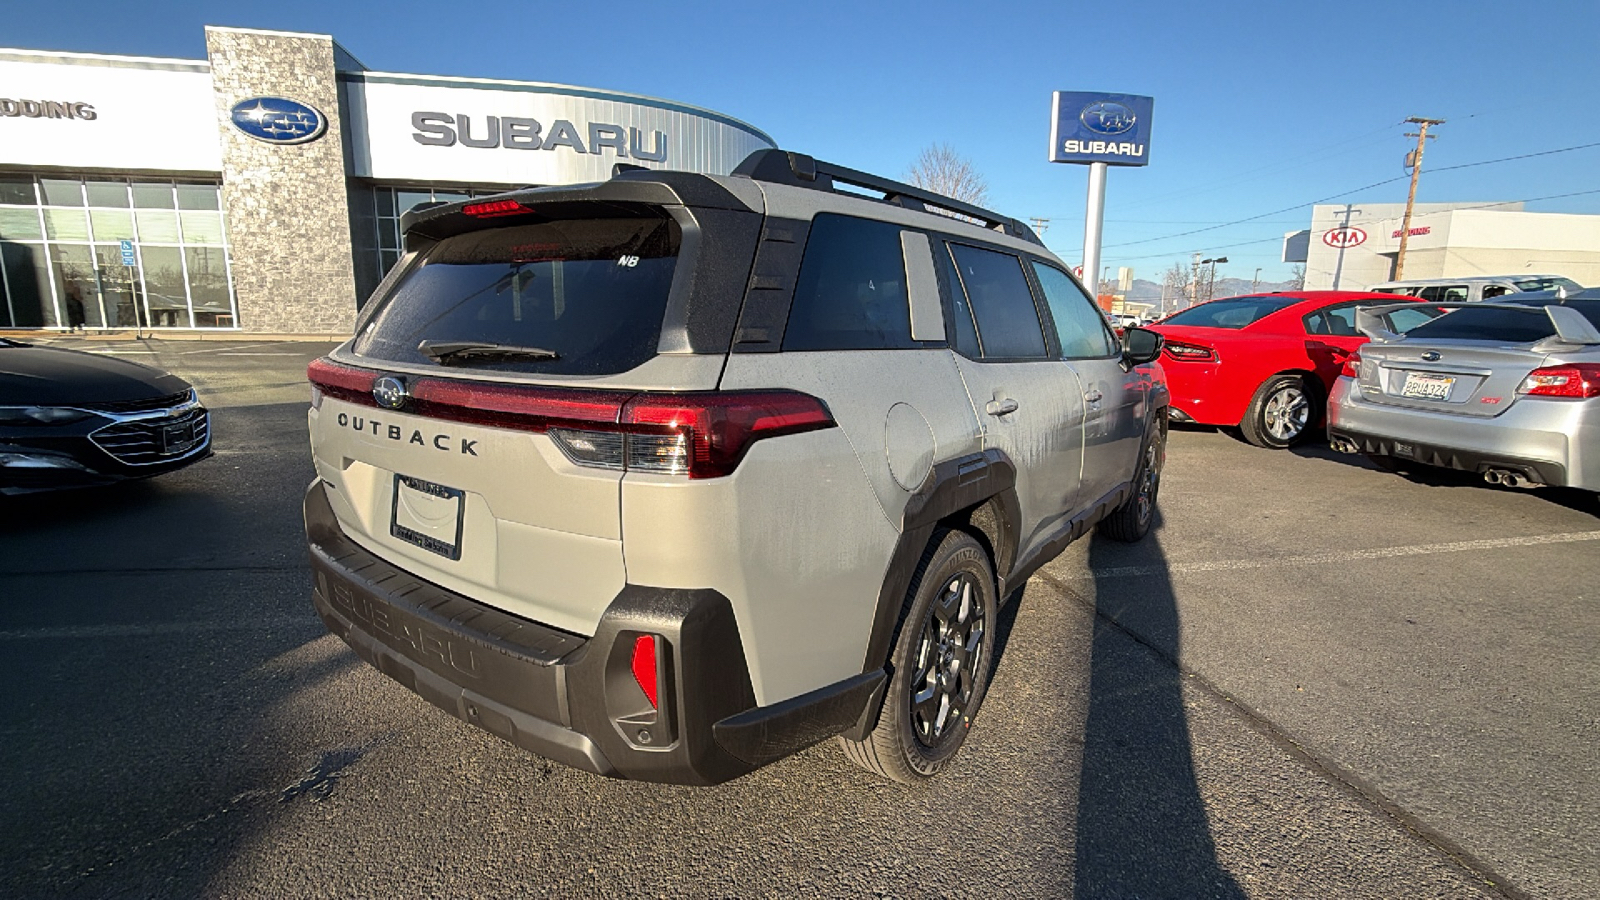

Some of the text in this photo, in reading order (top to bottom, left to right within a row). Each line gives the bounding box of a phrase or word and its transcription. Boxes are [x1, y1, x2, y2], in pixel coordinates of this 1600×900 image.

[411, 111, 668, 163] SUBARU
[1064, 140, 1144, 157] SUBARU
[1330, 231, 1359, 243] KIA
[1391, 226, 1431, 238] REDING
[337, 413, 478, 457] OUTBACK
[333, 584, 481, 679] SUBARU
